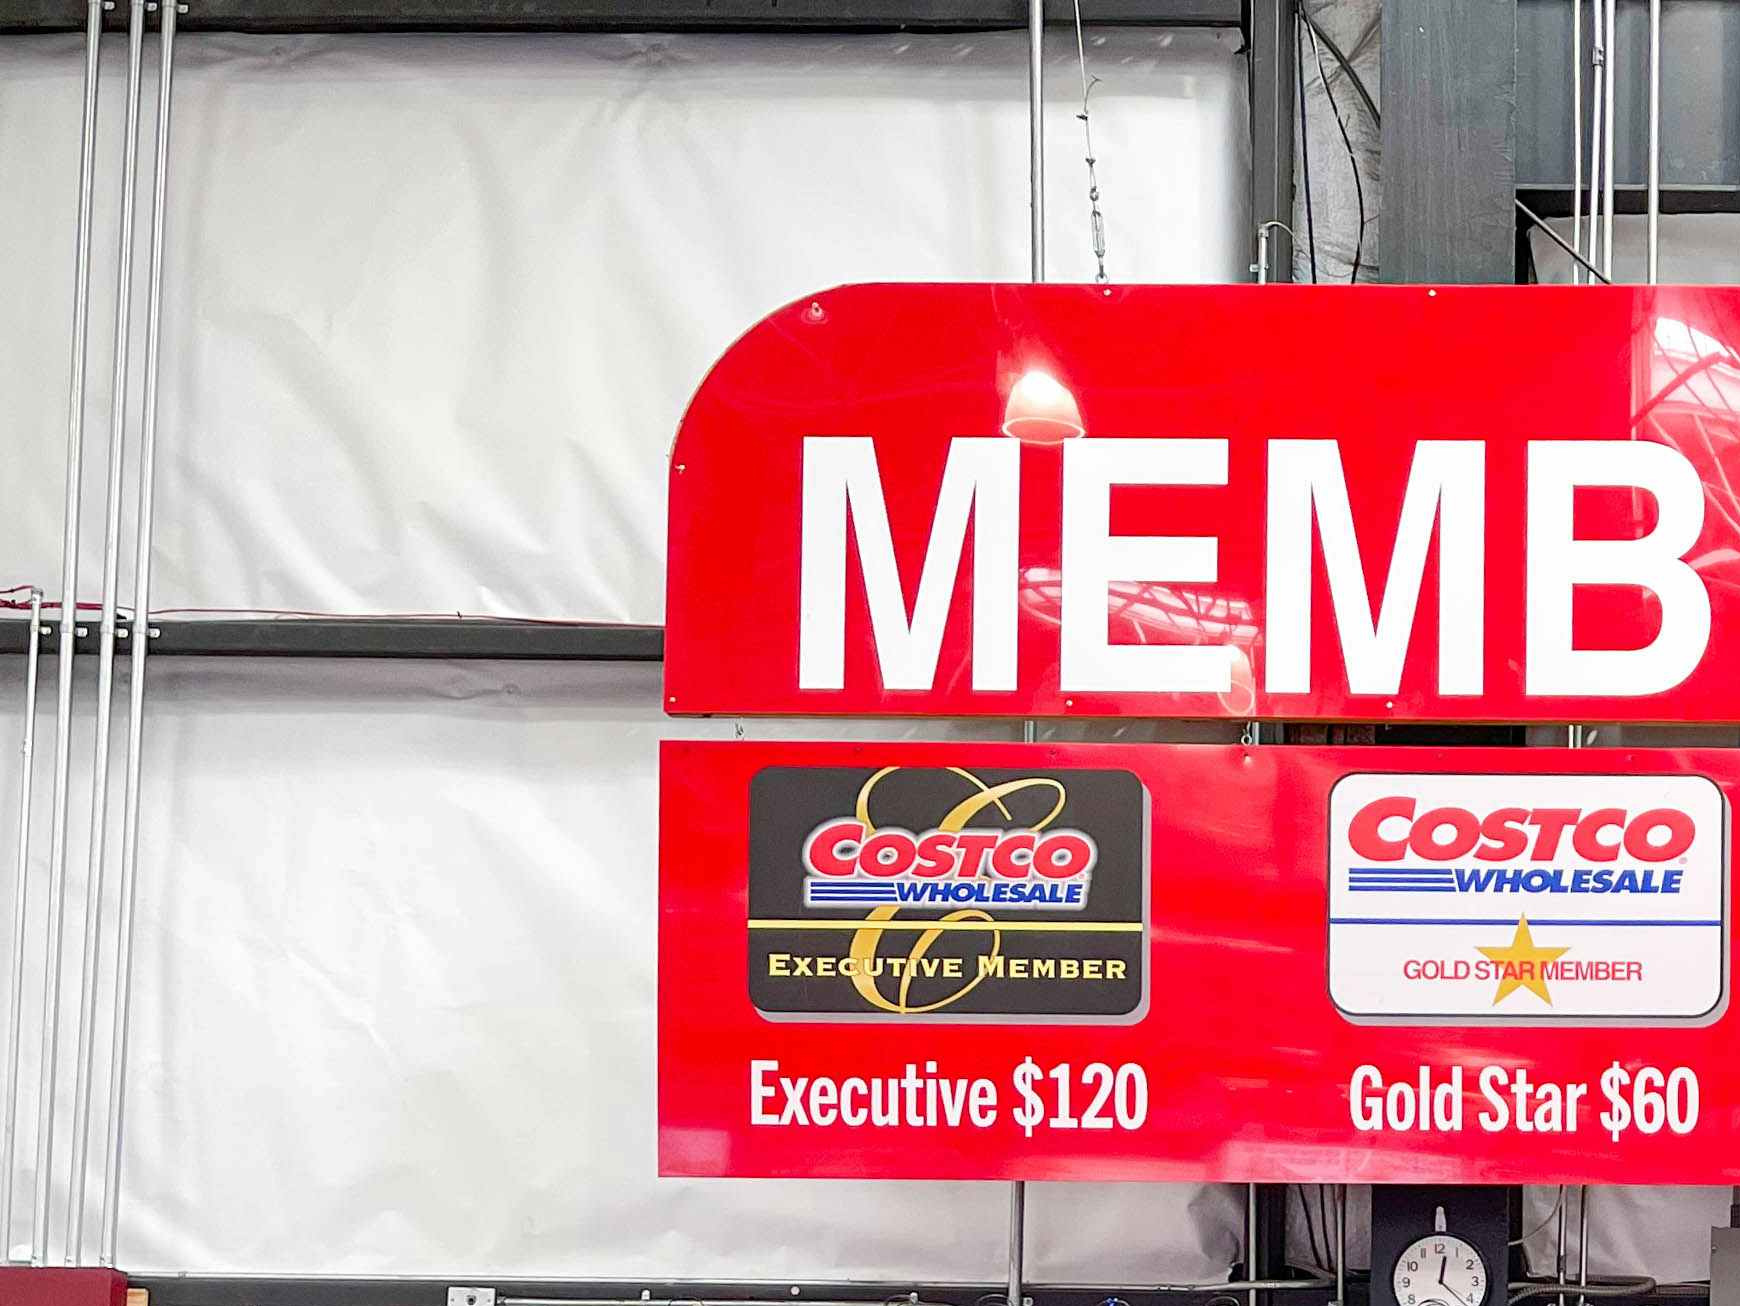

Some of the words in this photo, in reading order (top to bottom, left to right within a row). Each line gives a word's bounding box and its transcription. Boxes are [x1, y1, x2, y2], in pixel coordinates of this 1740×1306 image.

[1348, 796, 1696, 863] COSTCO
[810, 823, 1092, 879] COSTCO
[1454, 867, 1684, 894] WHOLESALE
[895, 881, 1082, 903] WHOLESALE
[977, 955, 1127, 980] MEMBER
[1403, 959, 1471, 981] GOLD
[1474, 960, 1535, 981] STAR
[1539, 960, 1643, 982] MEMBER
[750, 1059, 997, 1128] Executive
[1012, 1056, 1149, 1137] $120
[1349, 1064, 1463, 1133] Gold
[1478, 1066, 1588, 1134] Star
[1599, 1060, 1700, 1142] $60
[1434, 1243, 1446, 1255] 12
[1407, 1261, 1418, 1272] 10
[1465, 1259, 1474, 1270] 2
[1401, 1276, 1411, 1287] 9
[1471, 1276, 1479, 1286] 3
[1407, 1294, 1416, 1304] 8
